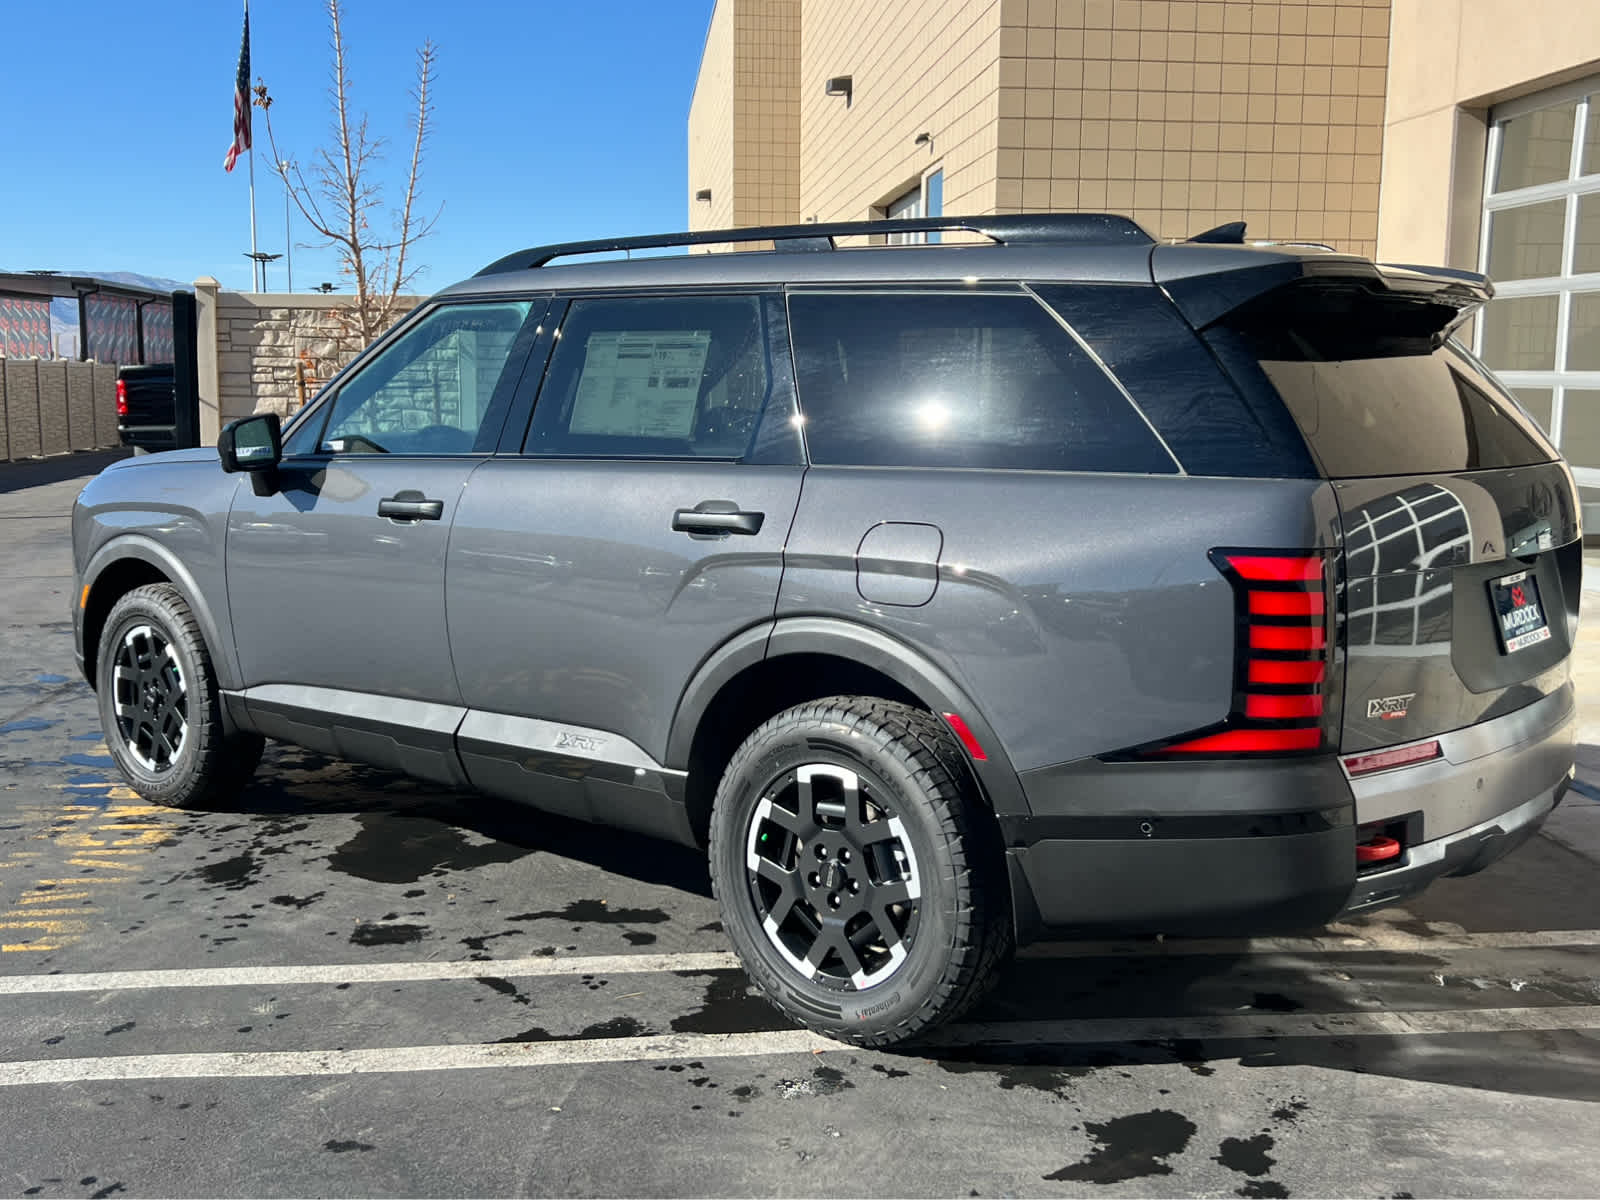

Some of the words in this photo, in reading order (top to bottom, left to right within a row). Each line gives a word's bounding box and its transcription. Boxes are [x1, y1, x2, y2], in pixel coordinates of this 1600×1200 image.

[1502, 603, 1540, 631] MURDOCK
[1367, 692, 1417, 718] XRT
[553, 731, 609, 751] XRT
